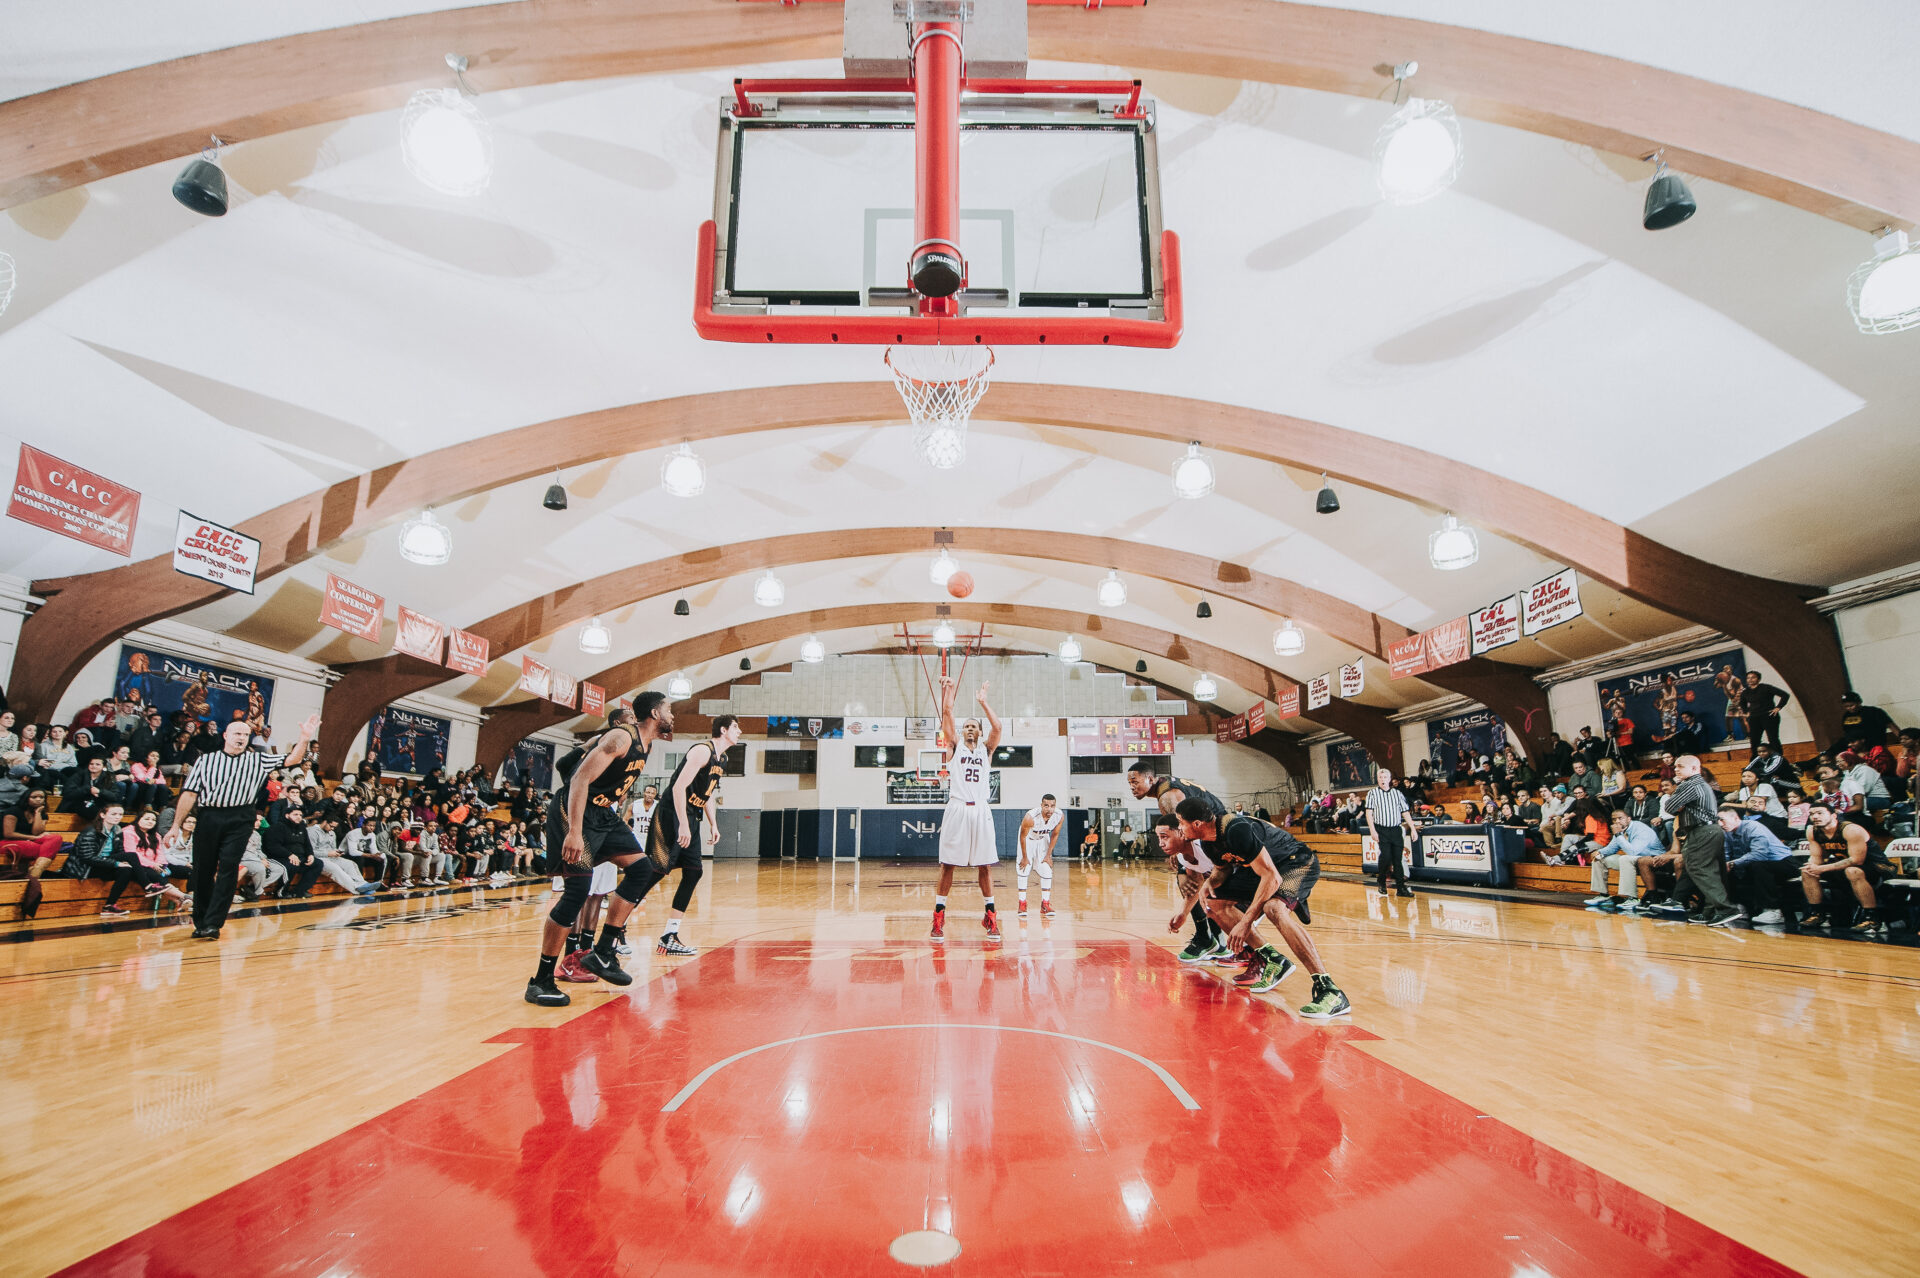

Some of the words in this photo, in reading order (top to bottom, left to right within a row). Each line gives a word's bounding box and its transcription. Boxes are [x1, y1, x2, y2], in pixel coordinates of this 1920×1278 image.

[17, 485, 81, 514] CONFERENCE
[48, 471, 112, 506] CACC
[14, 492, 58, 516] WOMEN'S
[59, 509, 88, 527] CROSS
[88, 520, 128, 541] COUNTRY
[195, 525, 243, 551] CACC
[184, 537, 248, 564] CHAMPION
[1528, 587, 1571, 612] CHAMPION
[1532, 578, 1562, 600] CACC
[330, 589, 377, 616] CONFERENCE
[1105, 724, 1118, 735] 27
[1156, 723, 1169, 735] 20
[1443, 713, 1489, 729] NYACK
[1127, 743, 1138, 752] 24
[1140, 743, 1147, 752] 2
[965, 768, 980, 783] 25
[639, 825, 649, 834] 12
[902, 820, 941, 833] NY
[1430, 838, 1486, 855] NYACK
